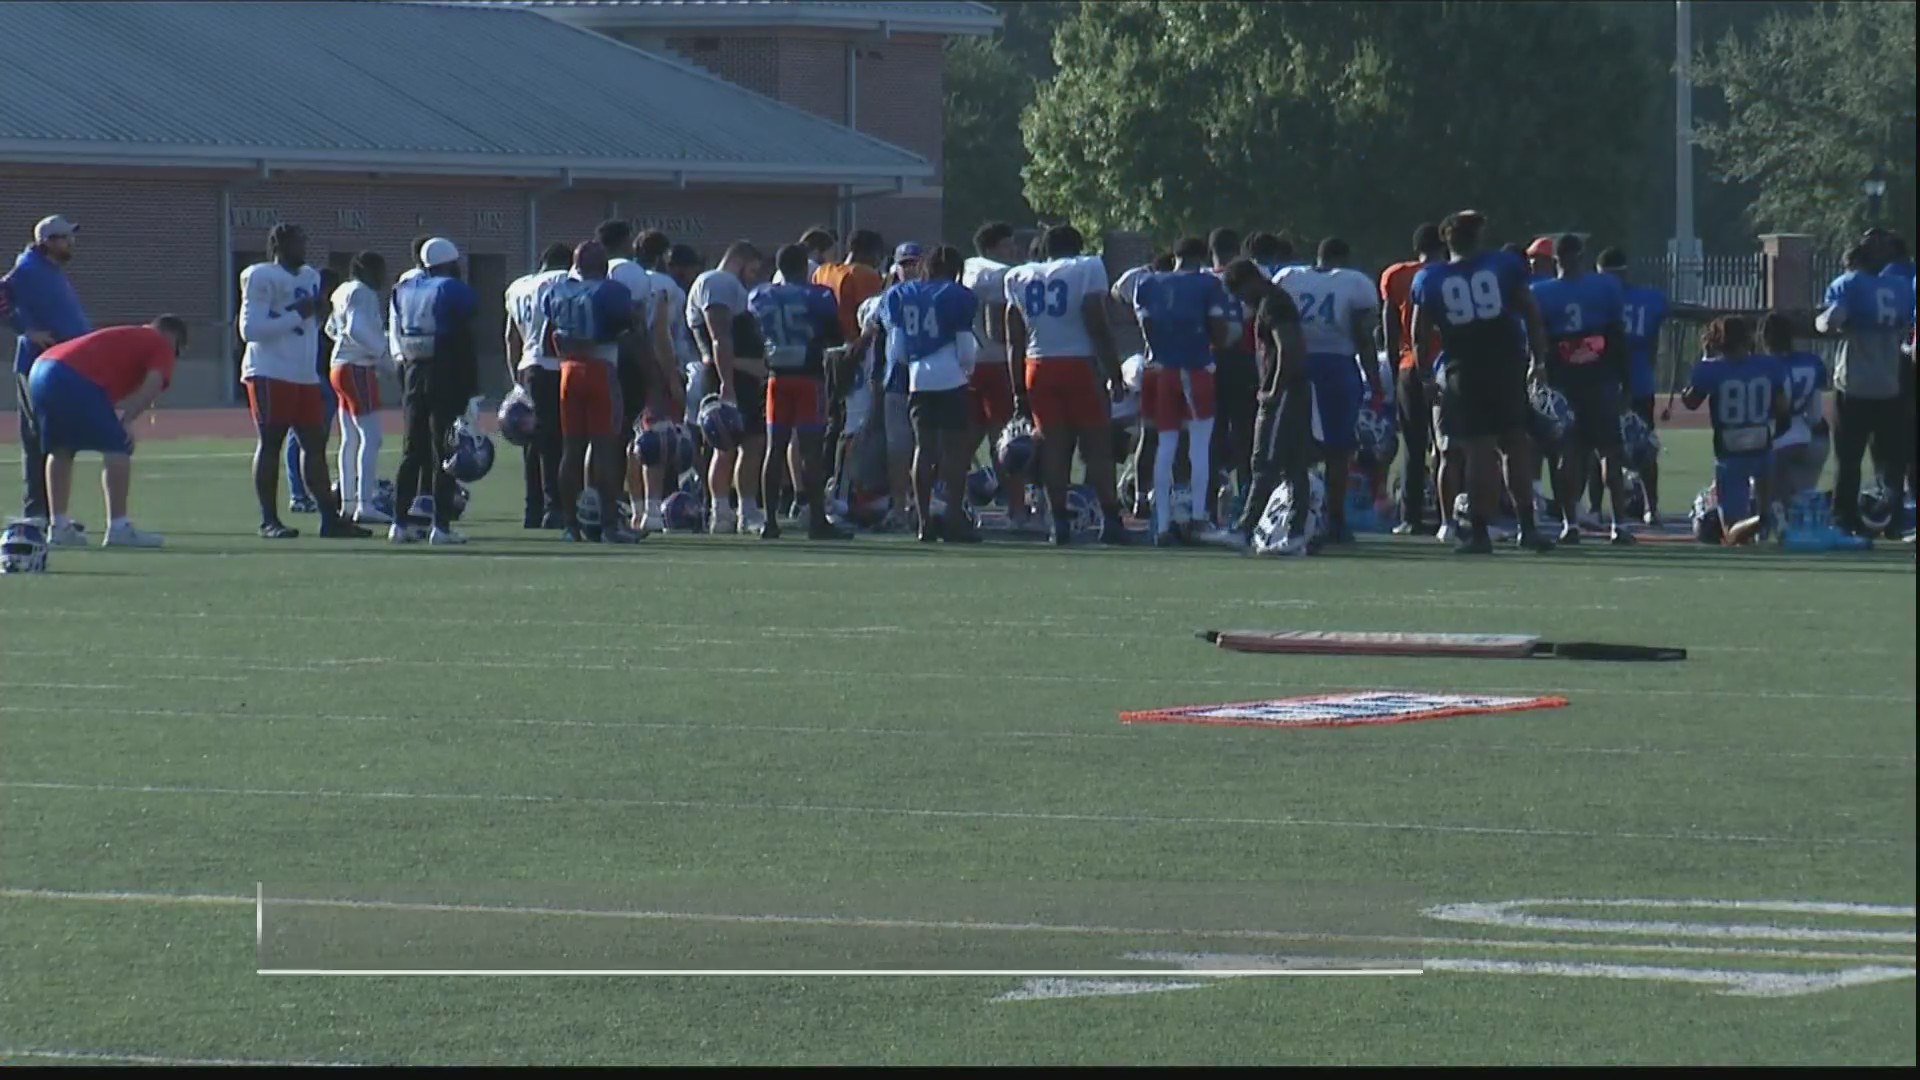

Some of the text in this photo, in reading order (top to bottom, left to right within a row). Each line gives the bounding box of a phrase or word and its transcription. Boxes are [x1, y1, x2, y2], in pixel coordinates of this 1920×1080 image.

[1025, 279, 1069, 318] 83
[1299, 292, 1337, 324] 24
[1442, 270, 1502, 325] 99
[903, 304, 939, 338] 84
[1564, 303, 1583, 332] 3
[1719, 377, 1772, 424] 80
